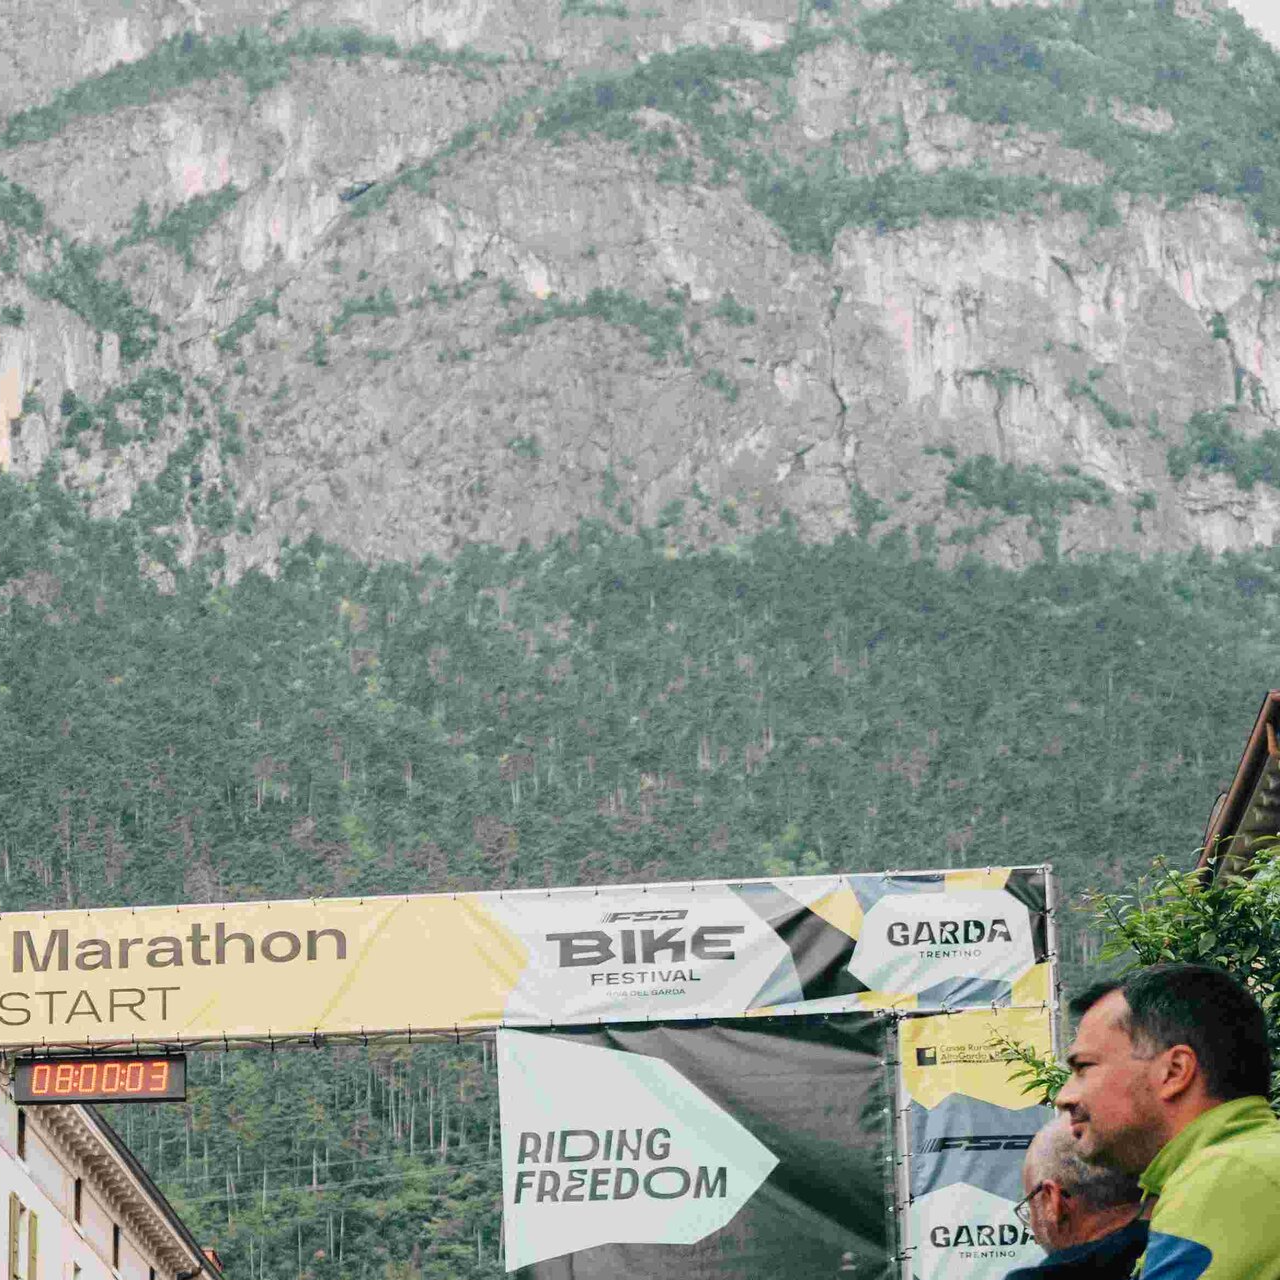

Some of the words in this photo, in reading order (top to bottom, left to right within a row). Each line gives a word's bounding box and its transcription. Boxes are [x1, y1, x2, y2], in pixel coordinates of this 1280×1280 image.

[546, 924, 745, 968] BIKE
[886, 918, 1013, 947] GARDA
[12, 921, 347, 974] Marathon
[918, 948, 982, 959] TRENTINO
[590, 968, 701, 986] FESTIVAL
[628, 988, 650, 996] DEL
[650, 987, 686, 996] GARDA
[940, 1051, 988, 1061] AltoGarda
[31, 1061, 169, 1095] 08:00:03
[517, 1128, 671, 1164] RIDING
[514, 1165, 728, 1204] FREEDOM
[959, 1251, 1016, 1259] TRENTINO
